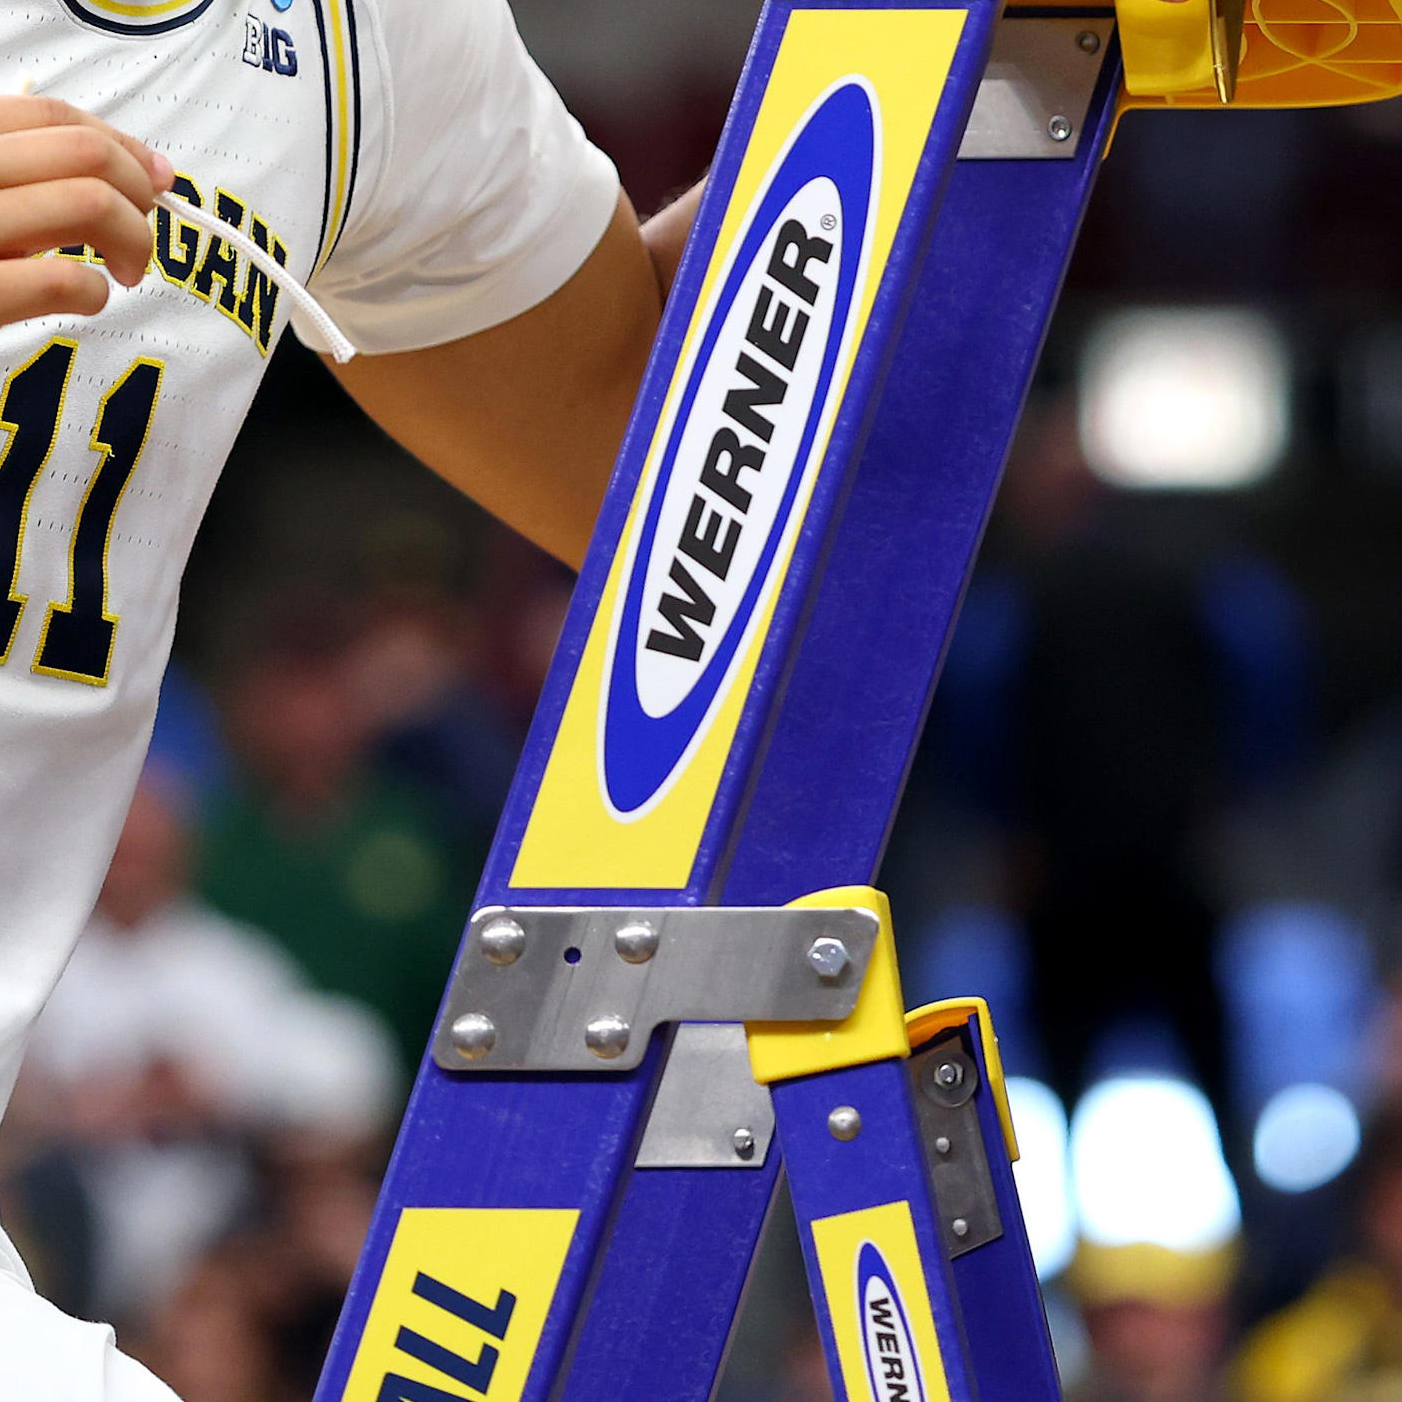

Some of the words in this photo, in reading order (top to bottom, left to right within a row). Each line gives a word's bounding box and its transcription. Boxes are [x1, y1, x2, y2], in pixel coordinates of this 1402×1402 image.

[646, 218, 834, 664] WERNER
[376, 1270, 517, 1402] 77
[869, 1297, 912, 1402] WERN
